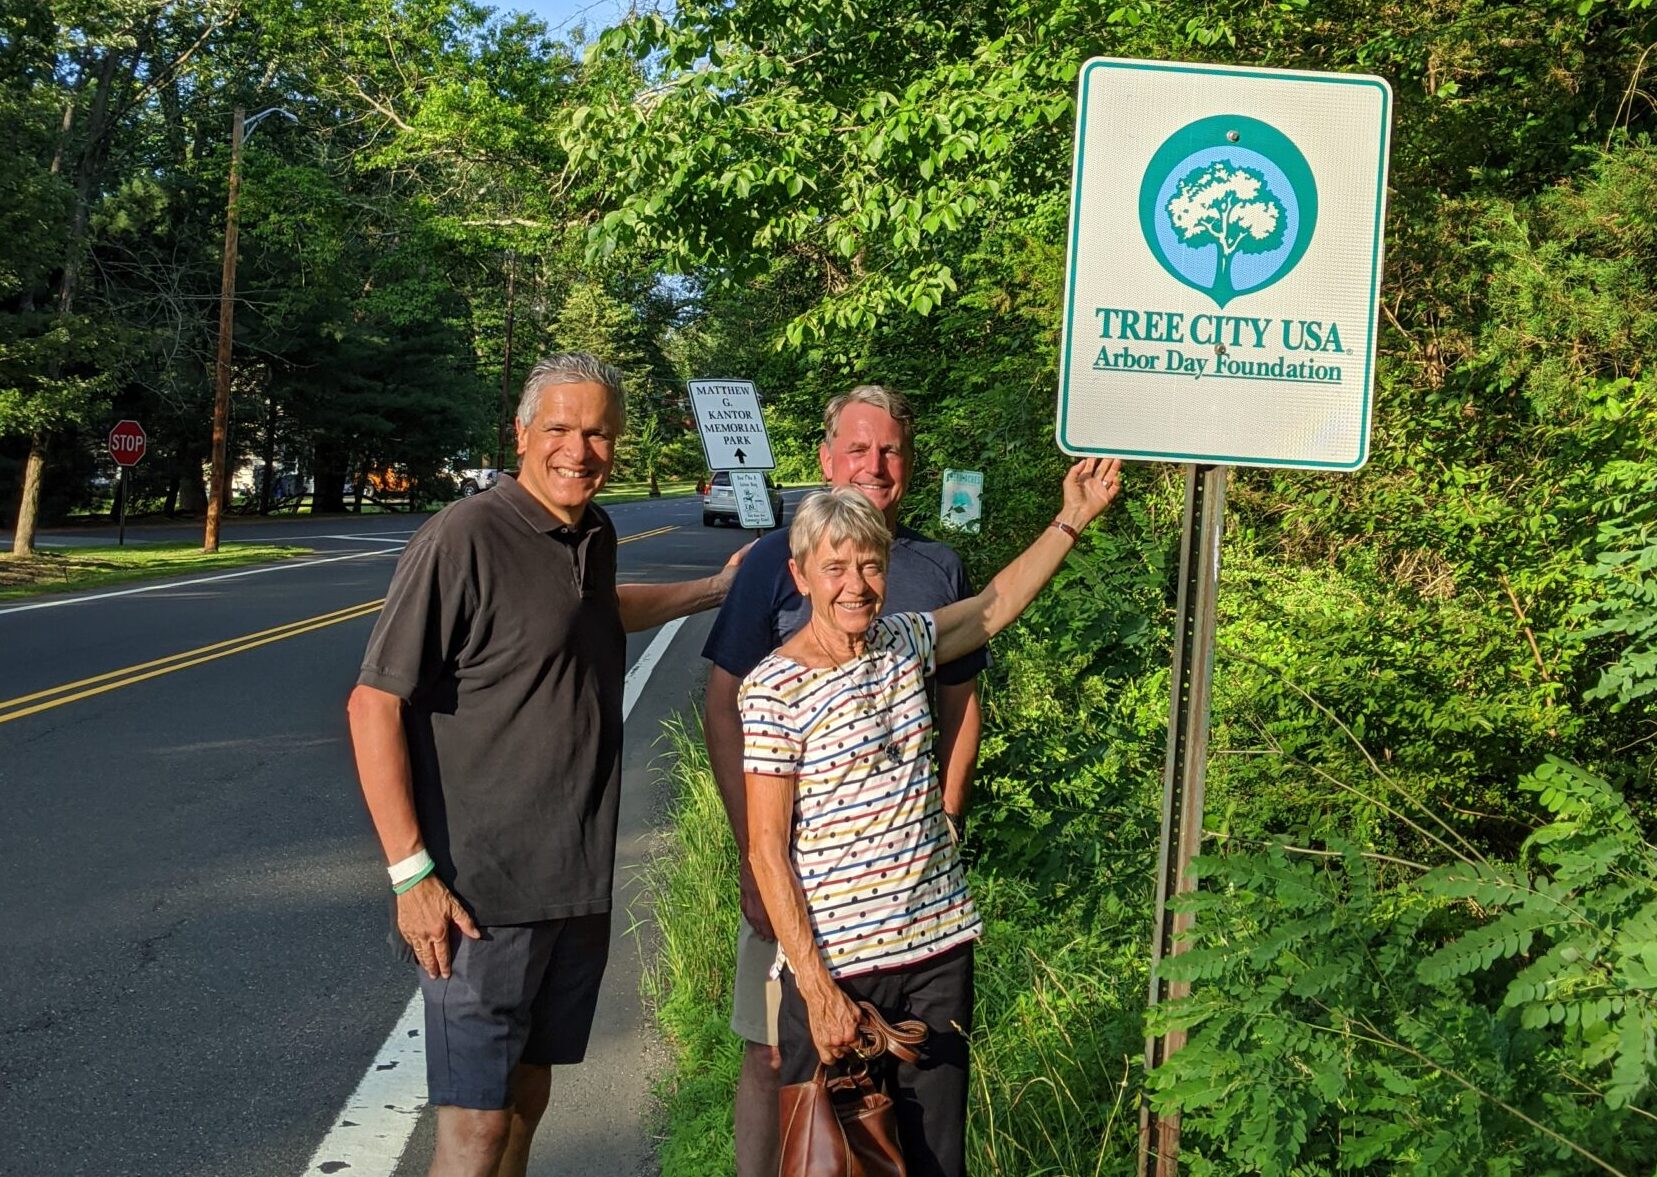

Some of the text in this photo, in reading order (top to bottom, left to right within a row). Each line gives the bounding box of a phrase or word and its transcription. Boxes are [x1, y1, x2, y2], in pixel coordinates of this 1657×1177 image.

[1095, 307, 1184, 343] TREE
[1190, 314, 1273, 348] CITY
[1093, 345, 1342, 382] Arbor Day Foundation
[696, 386, 750, 395] MATTHEW
[722, 398, 733, 407] G.
[708, 410, 753, 420] KANTOR
[704, 423, 763, 433] MEMORIAL
[111, 434, 144, 452] STOP
[723, 436, 752, 445] PARK
